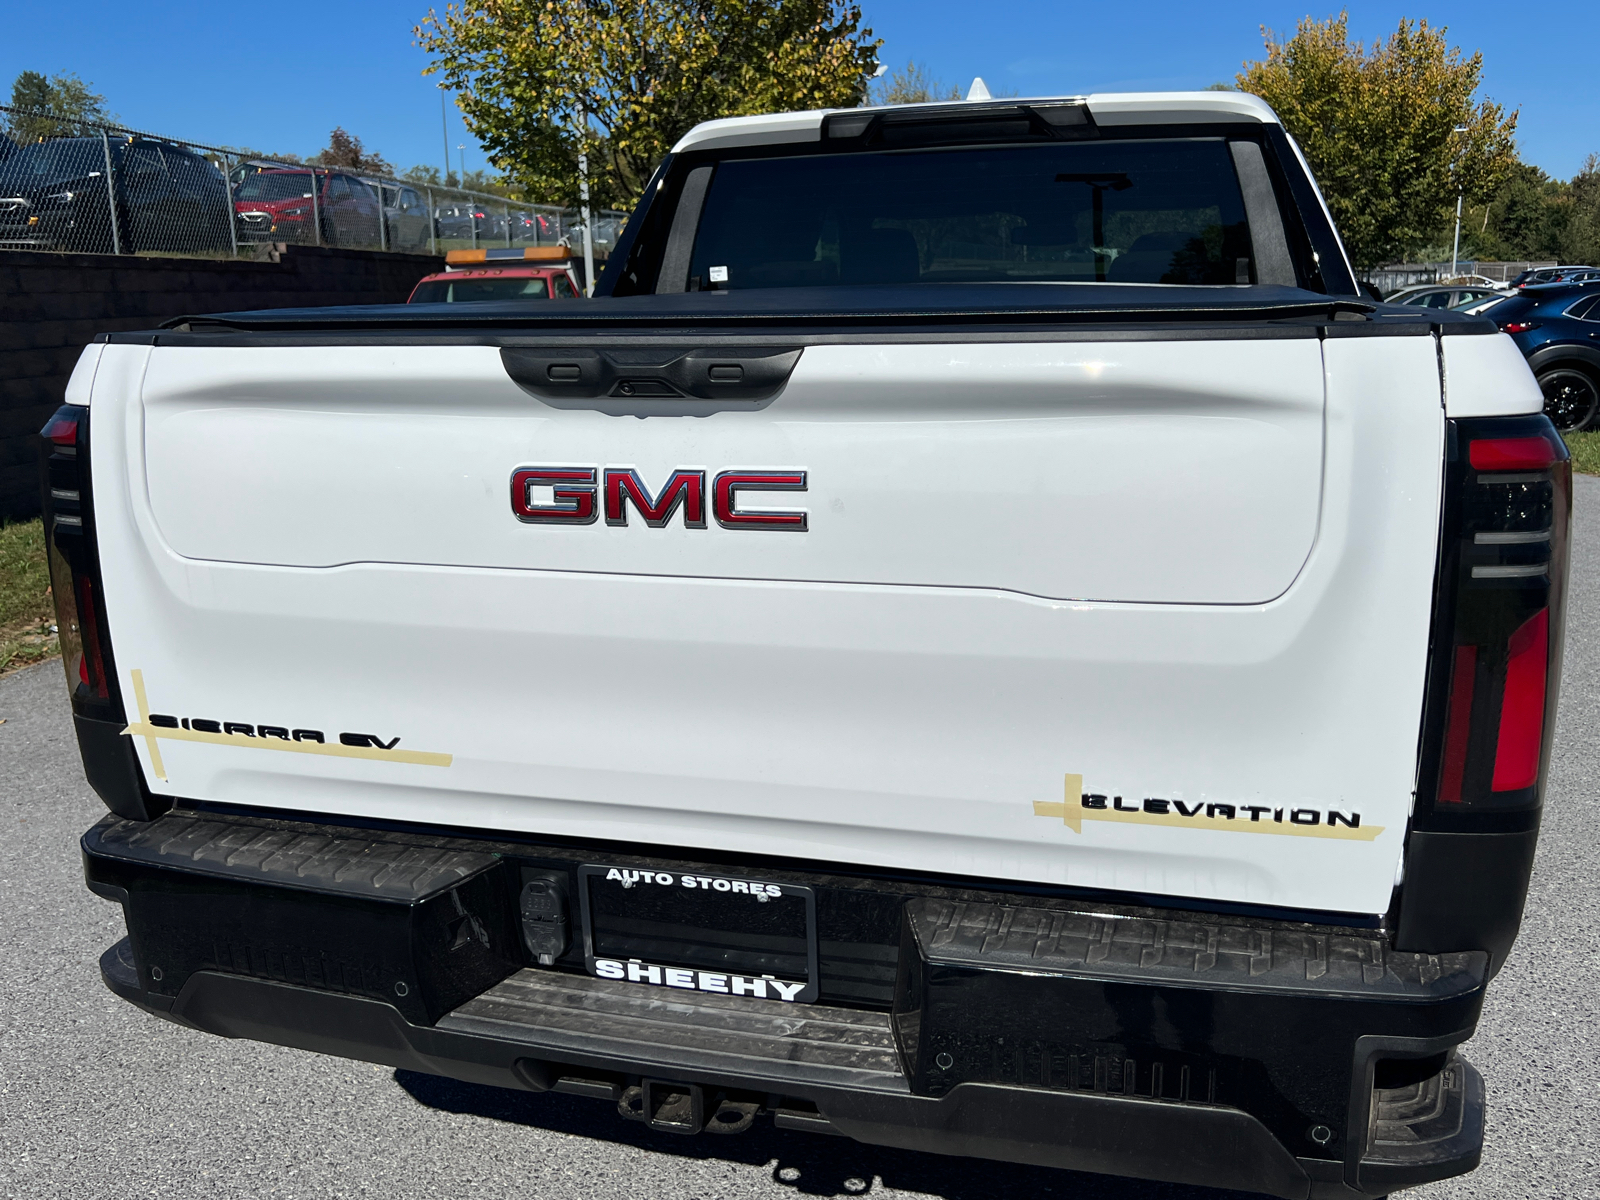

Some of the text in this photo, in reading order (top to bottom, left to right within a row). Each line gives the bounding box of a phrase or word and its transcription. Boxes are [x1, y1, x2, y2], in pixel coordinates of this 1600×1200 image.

[510, 465, 809, 533] GMC
[148, 713, 402, 750] SIERRA EV
[1081, 792, 1361, 828] ELEVATION
[605, 868, 783, 898] AUTO STORES
[595, 959, 806, 1002] SHEEHY
